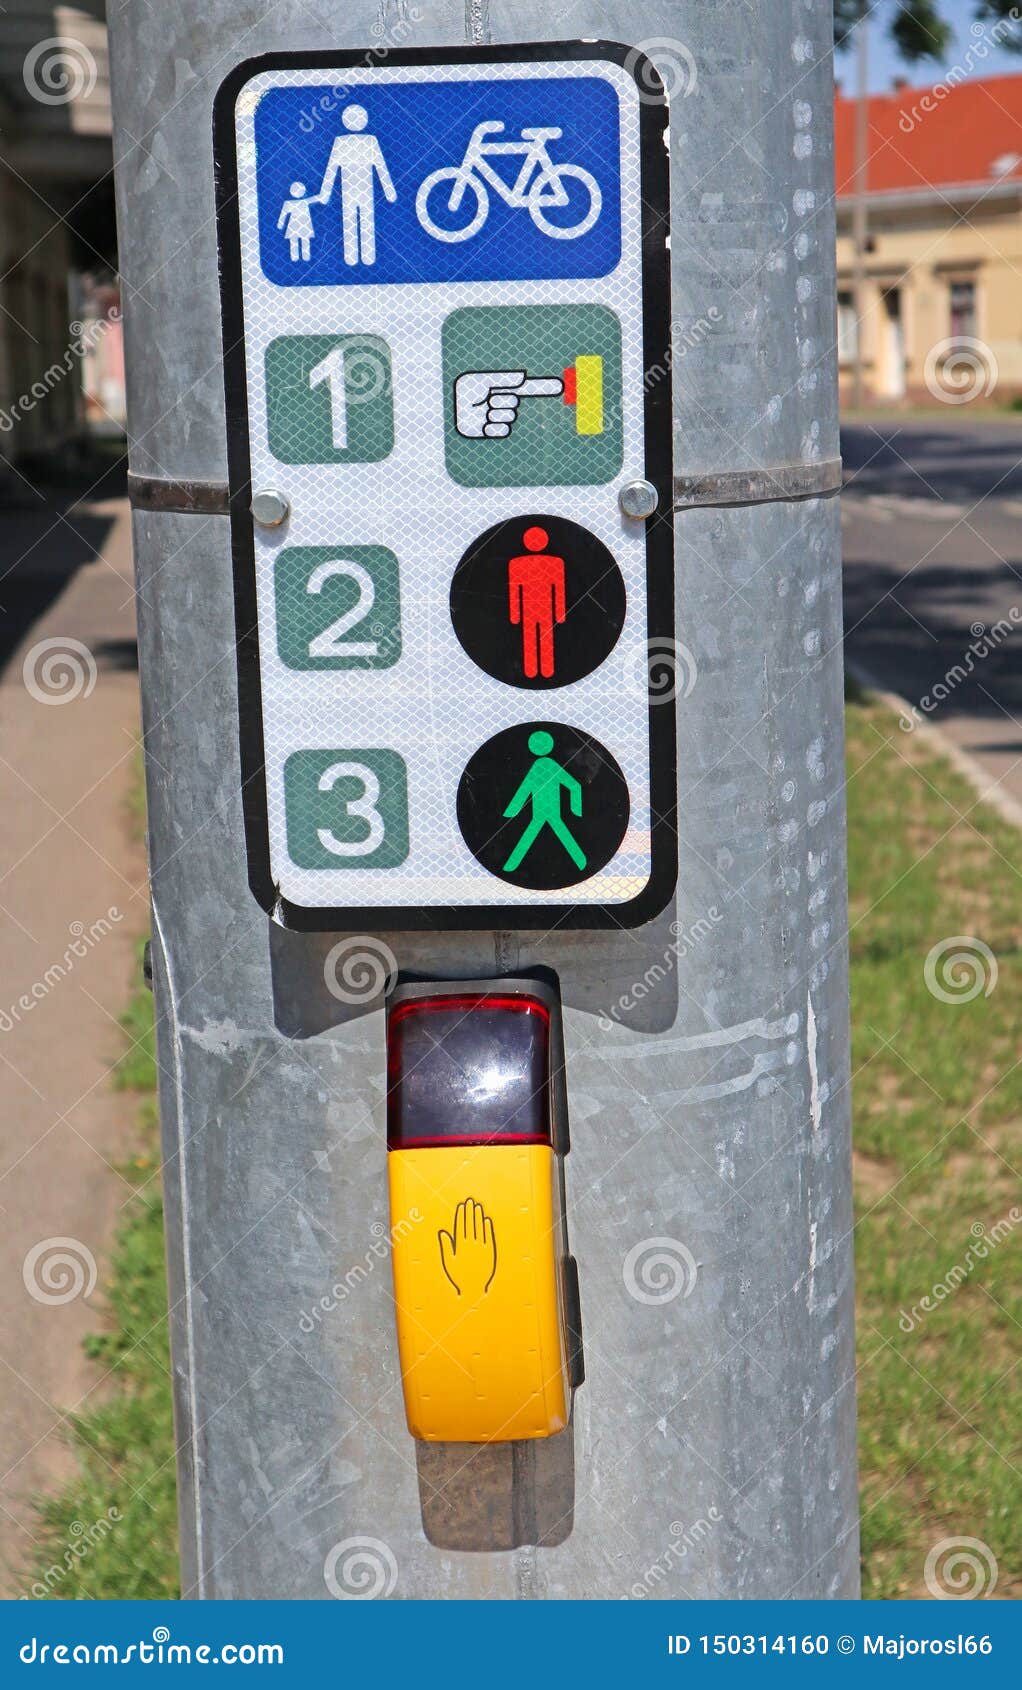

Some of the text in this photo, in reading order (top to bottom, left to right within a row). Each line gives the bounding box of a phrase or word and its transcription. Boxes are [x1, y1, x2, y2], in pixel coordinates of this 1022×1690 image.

[309, 349, 348, 449] 1
[306, 559, 378, 657] 2
[317, 762, 385, 857] 3
